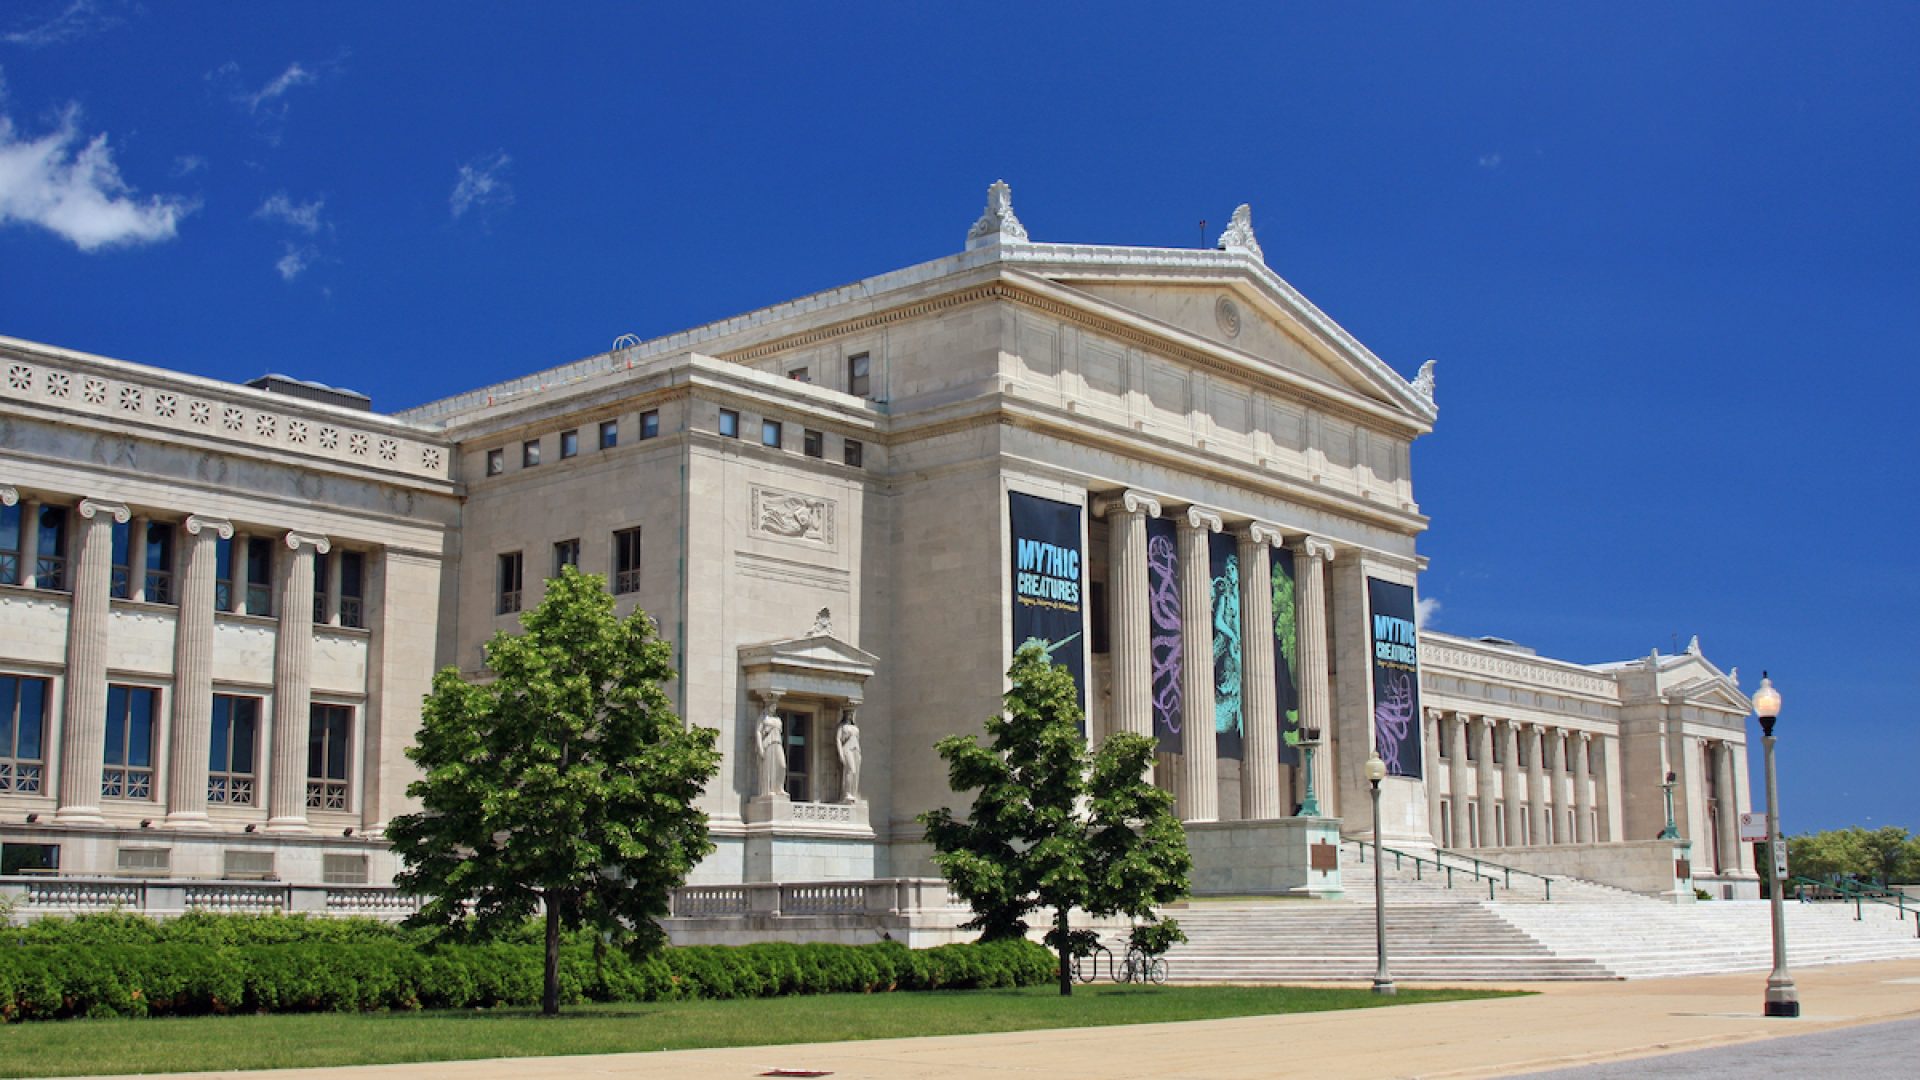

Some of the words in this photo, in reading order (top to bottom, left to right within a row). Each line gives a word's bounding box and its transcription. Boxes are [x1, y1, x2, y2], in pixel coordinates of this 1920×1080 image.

[1018, 538, 1079, 580] MYTHIC
[1017, 572, 1079, 603] CREATURES
[1374, 614, 1415, 647] MYTHIC
